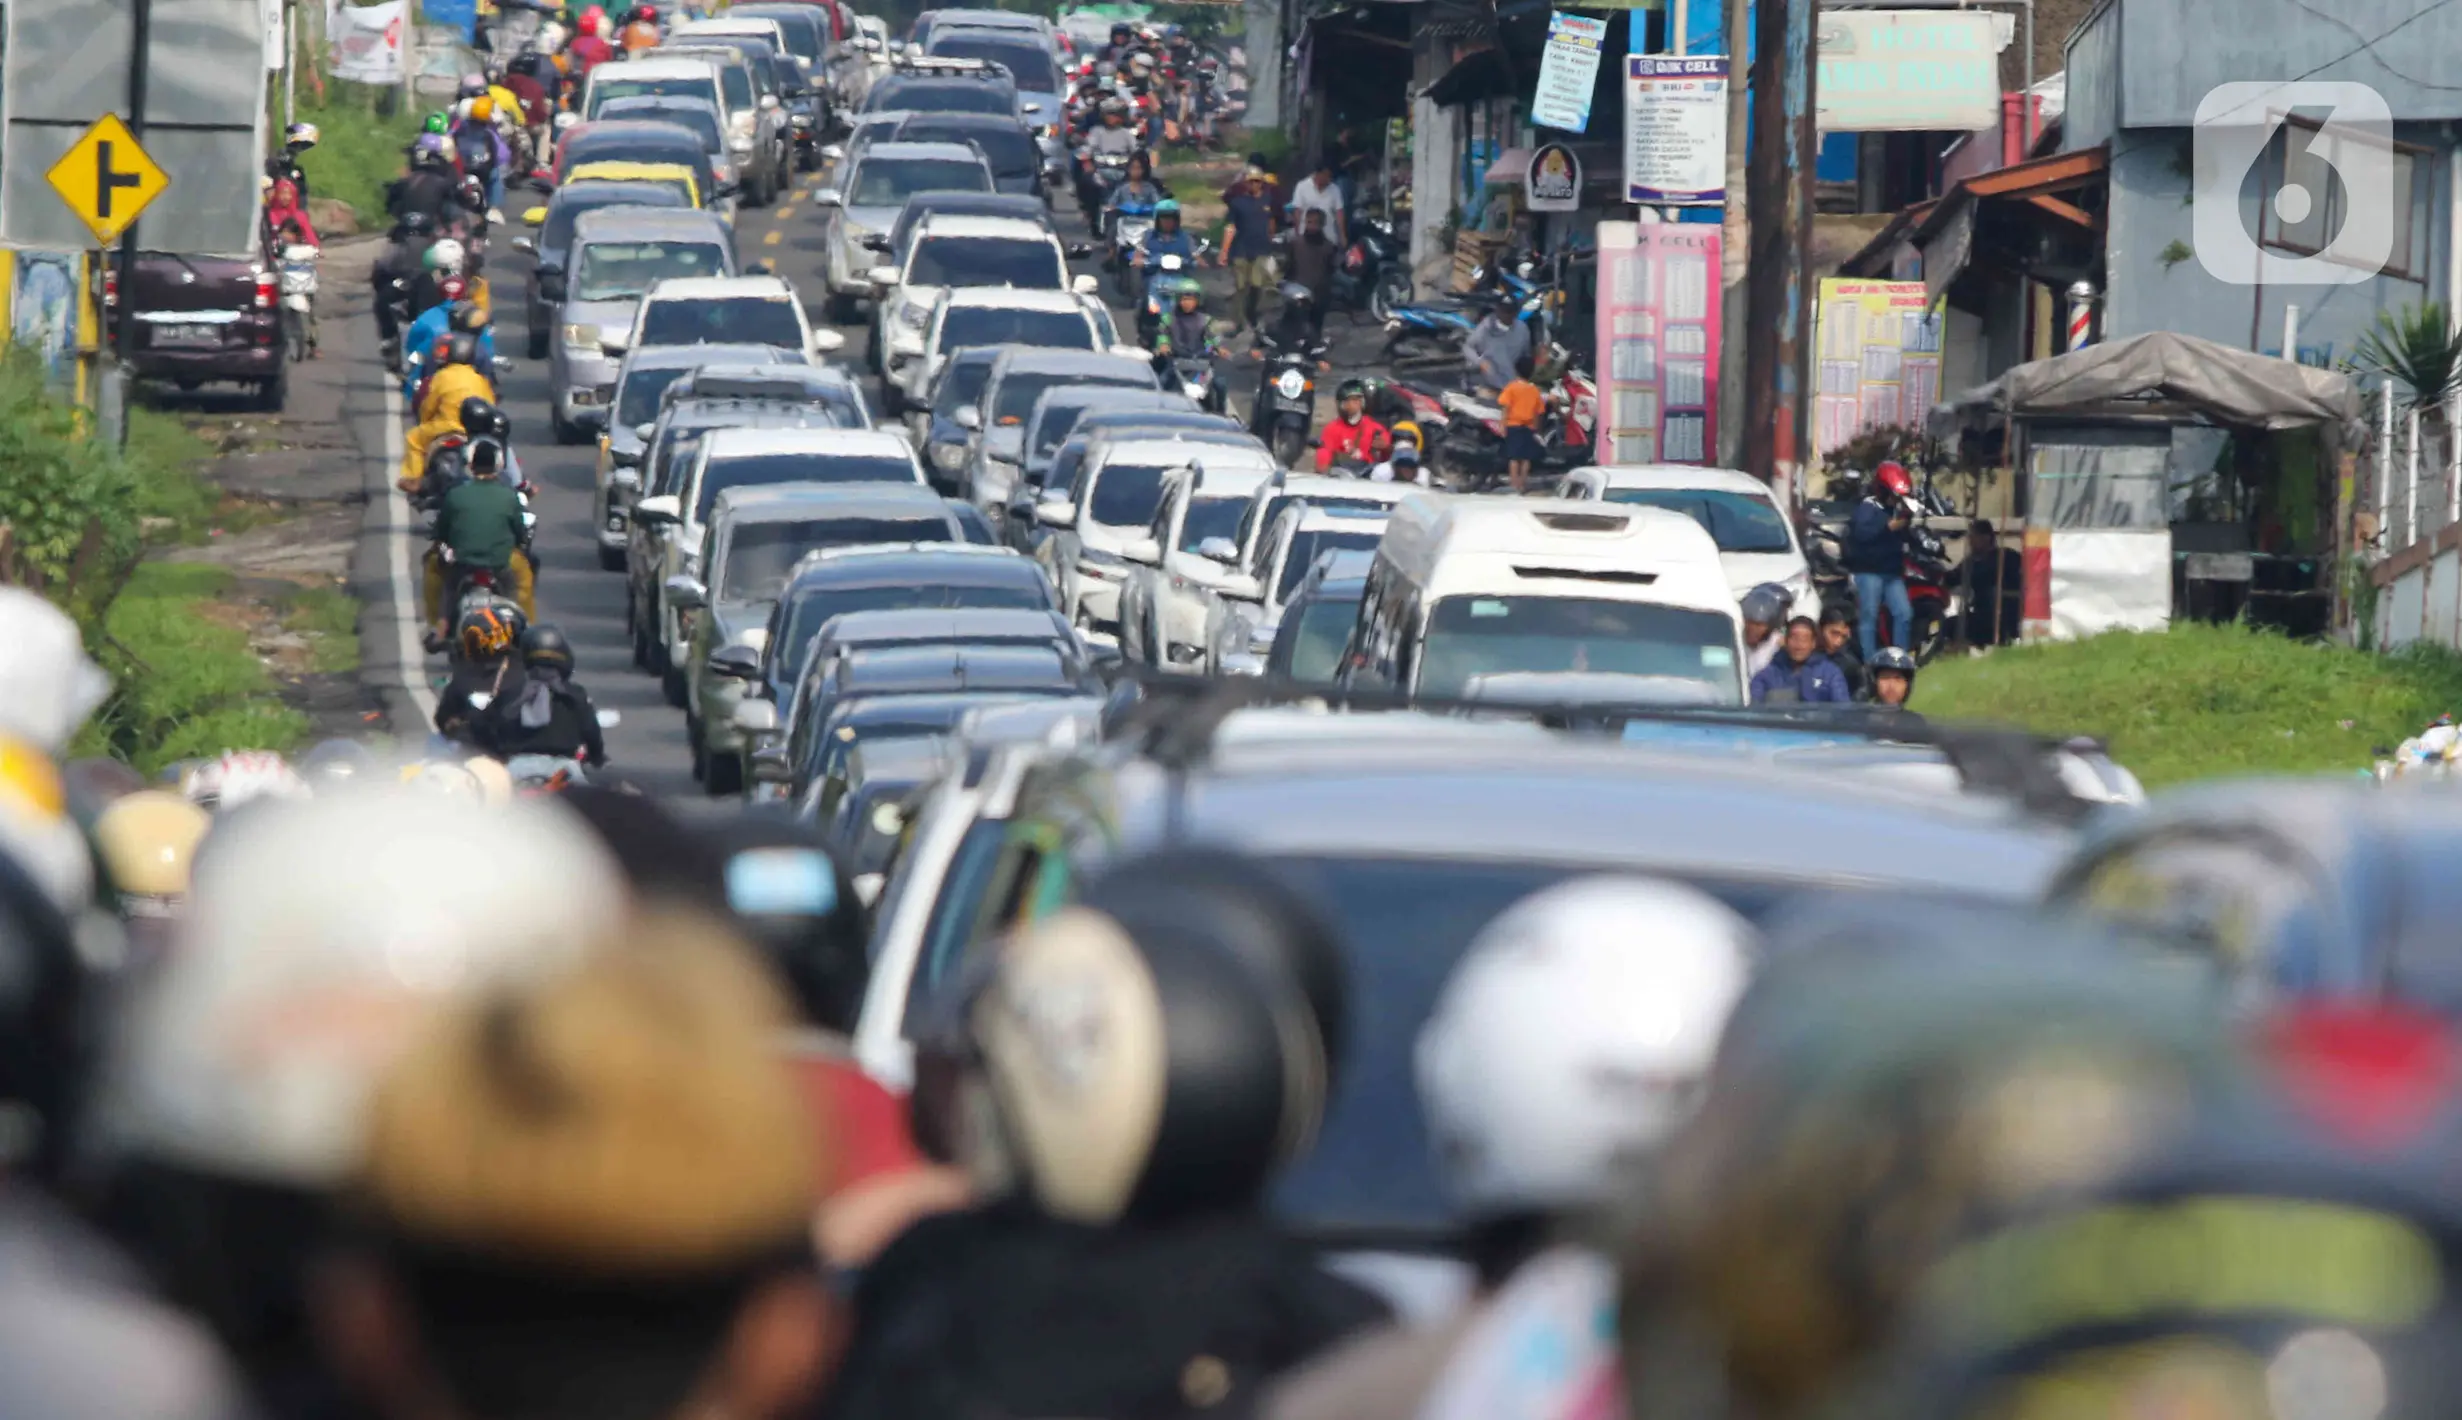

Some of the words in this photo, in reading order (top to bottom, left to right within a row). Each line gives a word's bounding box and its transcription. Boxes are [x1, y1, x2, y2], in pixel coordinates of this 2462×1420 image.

[1870, 25, 1981, 50] HOTEL
[1685, 60, 1719, 73] CELL
[1898, 60, 1989, 90] INDAH
